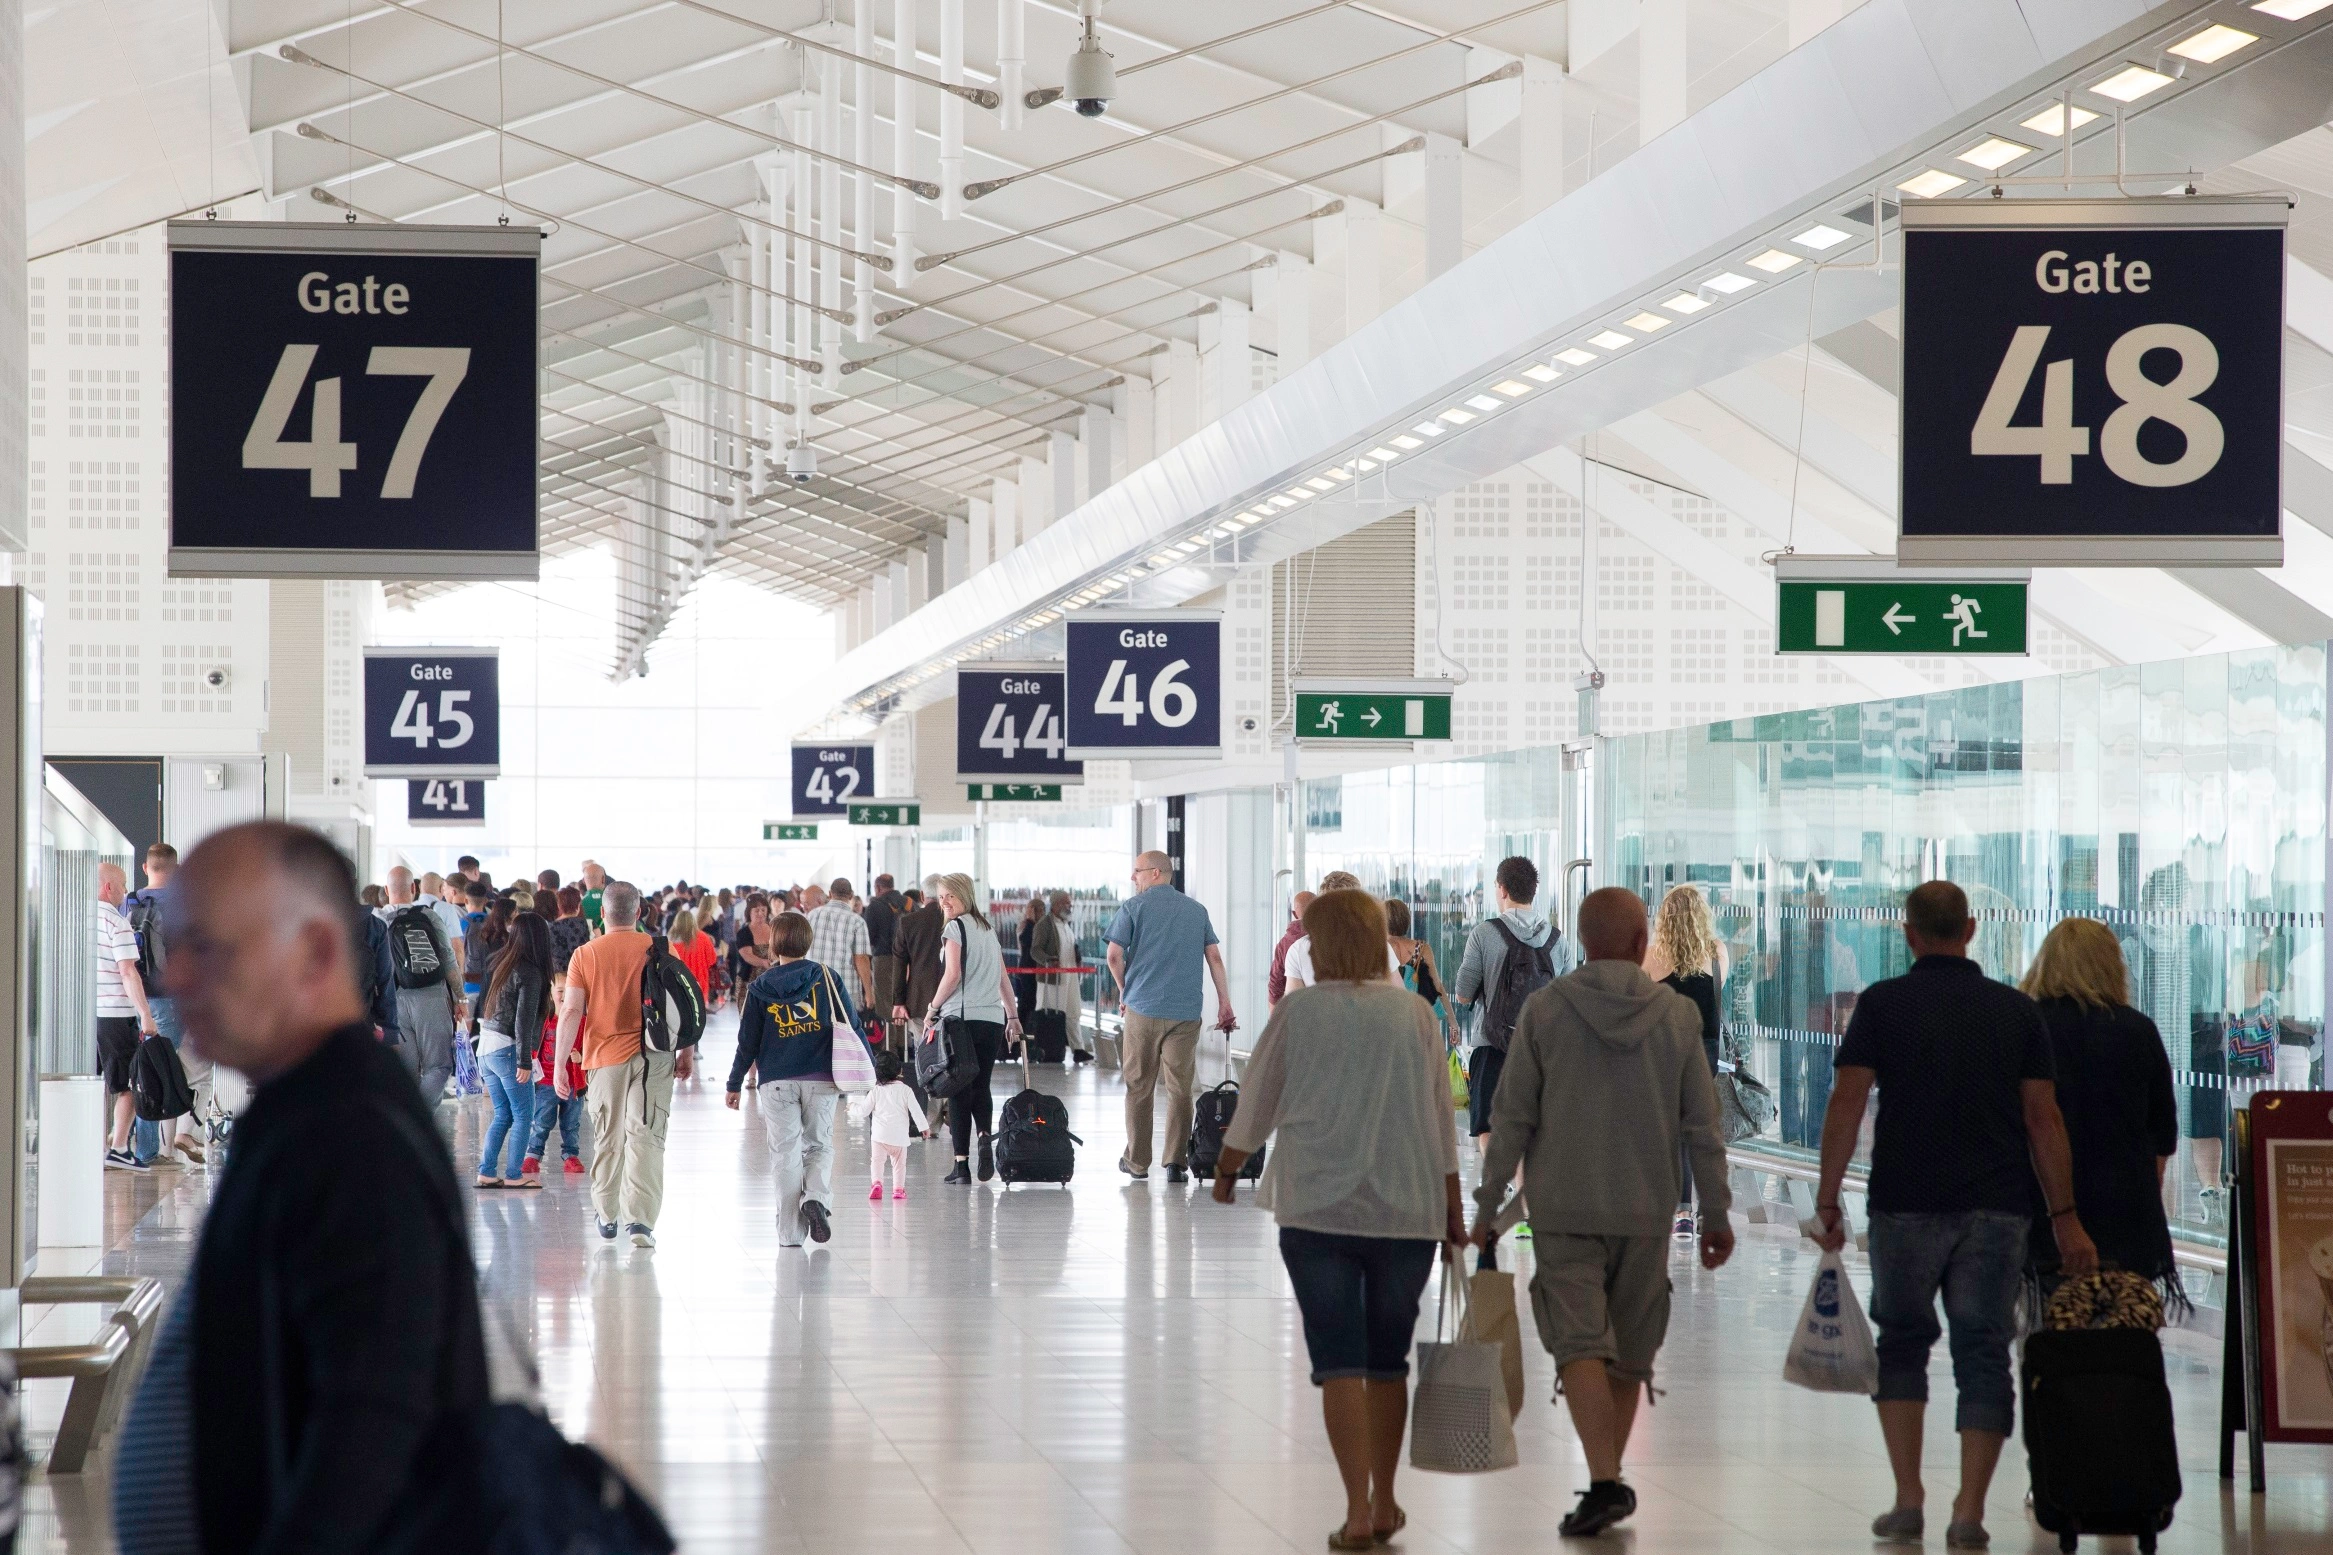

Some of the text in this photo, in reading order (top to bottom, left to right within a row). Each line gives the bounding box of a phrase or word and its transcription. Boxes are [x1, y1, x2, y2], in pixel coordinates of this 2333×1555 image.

[2035, 250, 2152, 294] Gate
[297, 271, 410, 315] Gate
[241, 343, 472, 499] 47
[1970, 323, 2225, 488] 48
[1119, 628, 1168, 649] Gate
[410, 663, 453, 681] Gate
[1000, 678, 1041, 695] Gate
[1094, 658, 1198, 728] 46
[390, 689, 474, 749] 45
[979, 703, 1064, 759] 44
[819, 750, 847, 763] Gate
[421, 780, 470, 811] 41
[805, 766, 860, 804] 42
[778, 1020, 822, 1038] SAINTS
[2287, 1164, 2307, 1174] Hot
[2310, 1165, 2323, 1175] to
[2301, 1177, 2324, 1189] just
